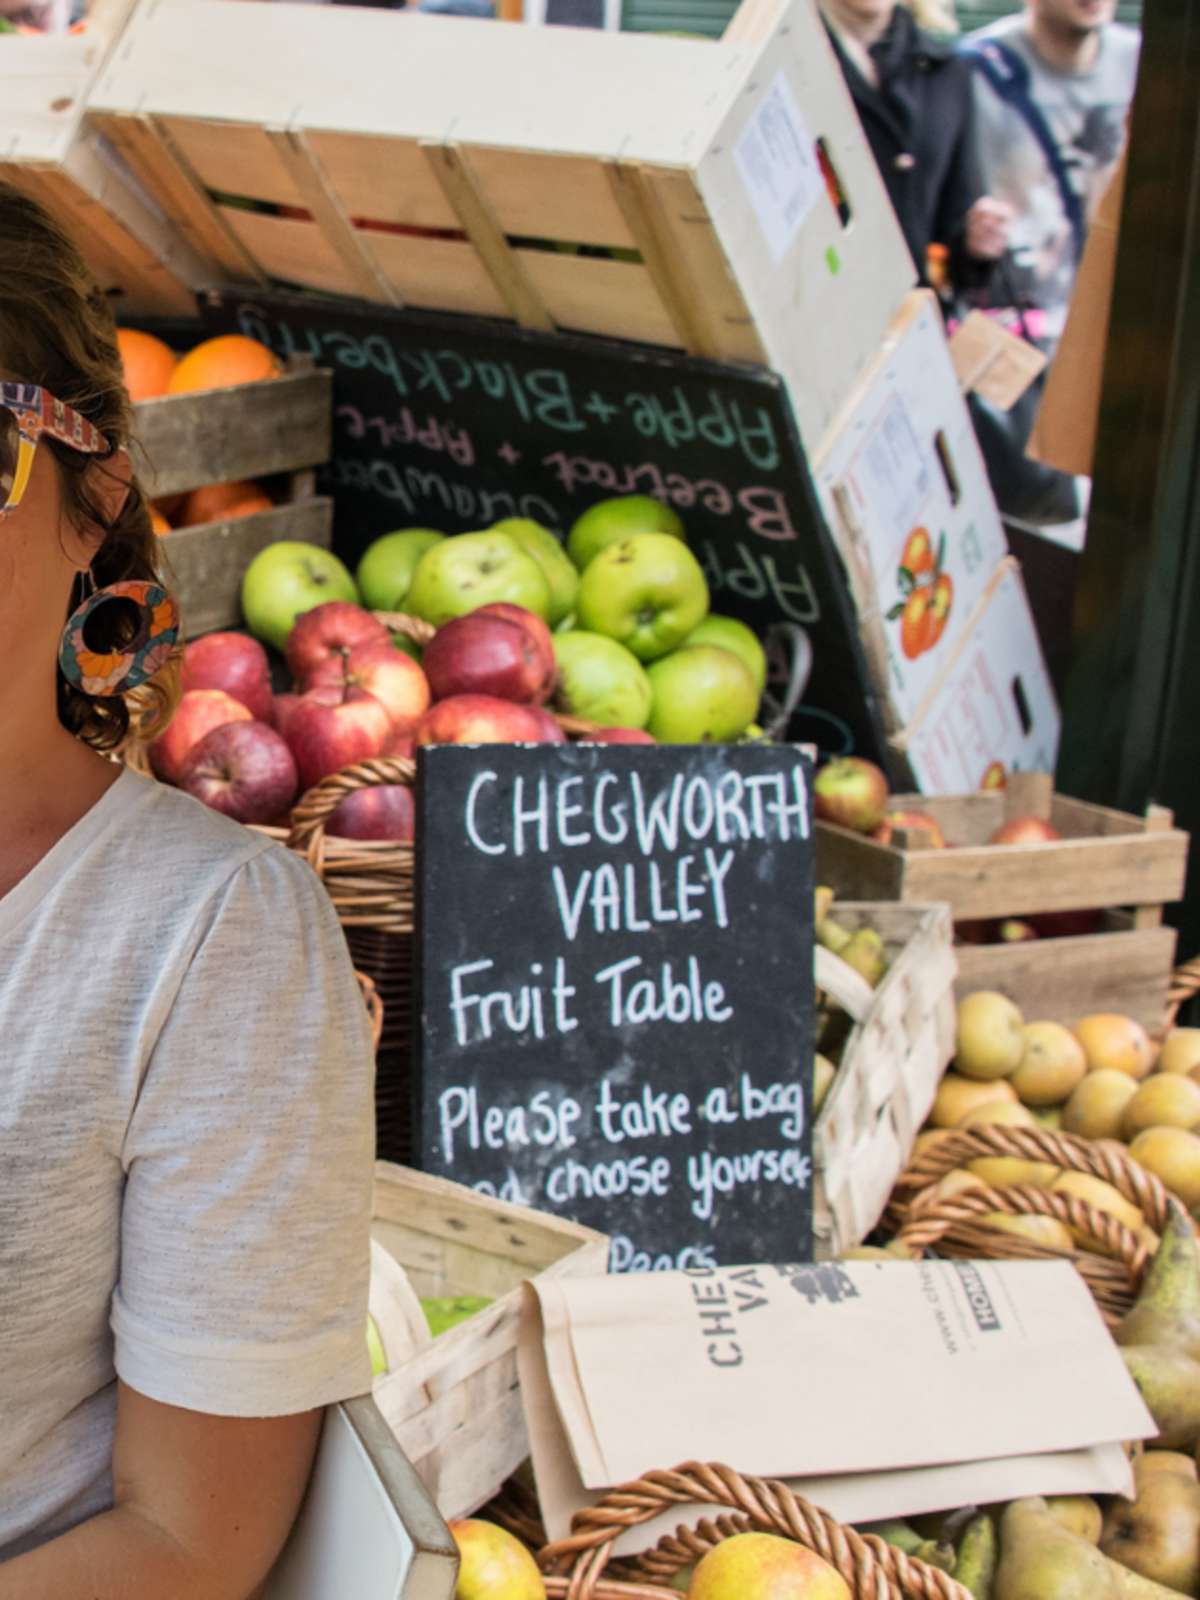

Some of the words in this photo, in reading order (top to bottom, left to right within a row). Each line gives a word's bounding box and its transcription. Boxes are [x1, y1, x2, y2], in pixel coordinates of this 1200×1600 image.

[626, 387, 780, 471] Apple
[543, 449, 797, 542] Beetroot
[465, 764, 810, 857] CHEGWORTH
[552, 847, 735, 940] VALLEY
[450, 956, 579, 1046] Fruit
[595, 955, 734, 1027] Table
[438, 1084, 582, 1164] Please
[596, 1078, 693, 1144] take
[705, 1086, 739, 1124] a
[742, 1073, 804, 1140] bag
[546, 1156, 670, 1202] choose
